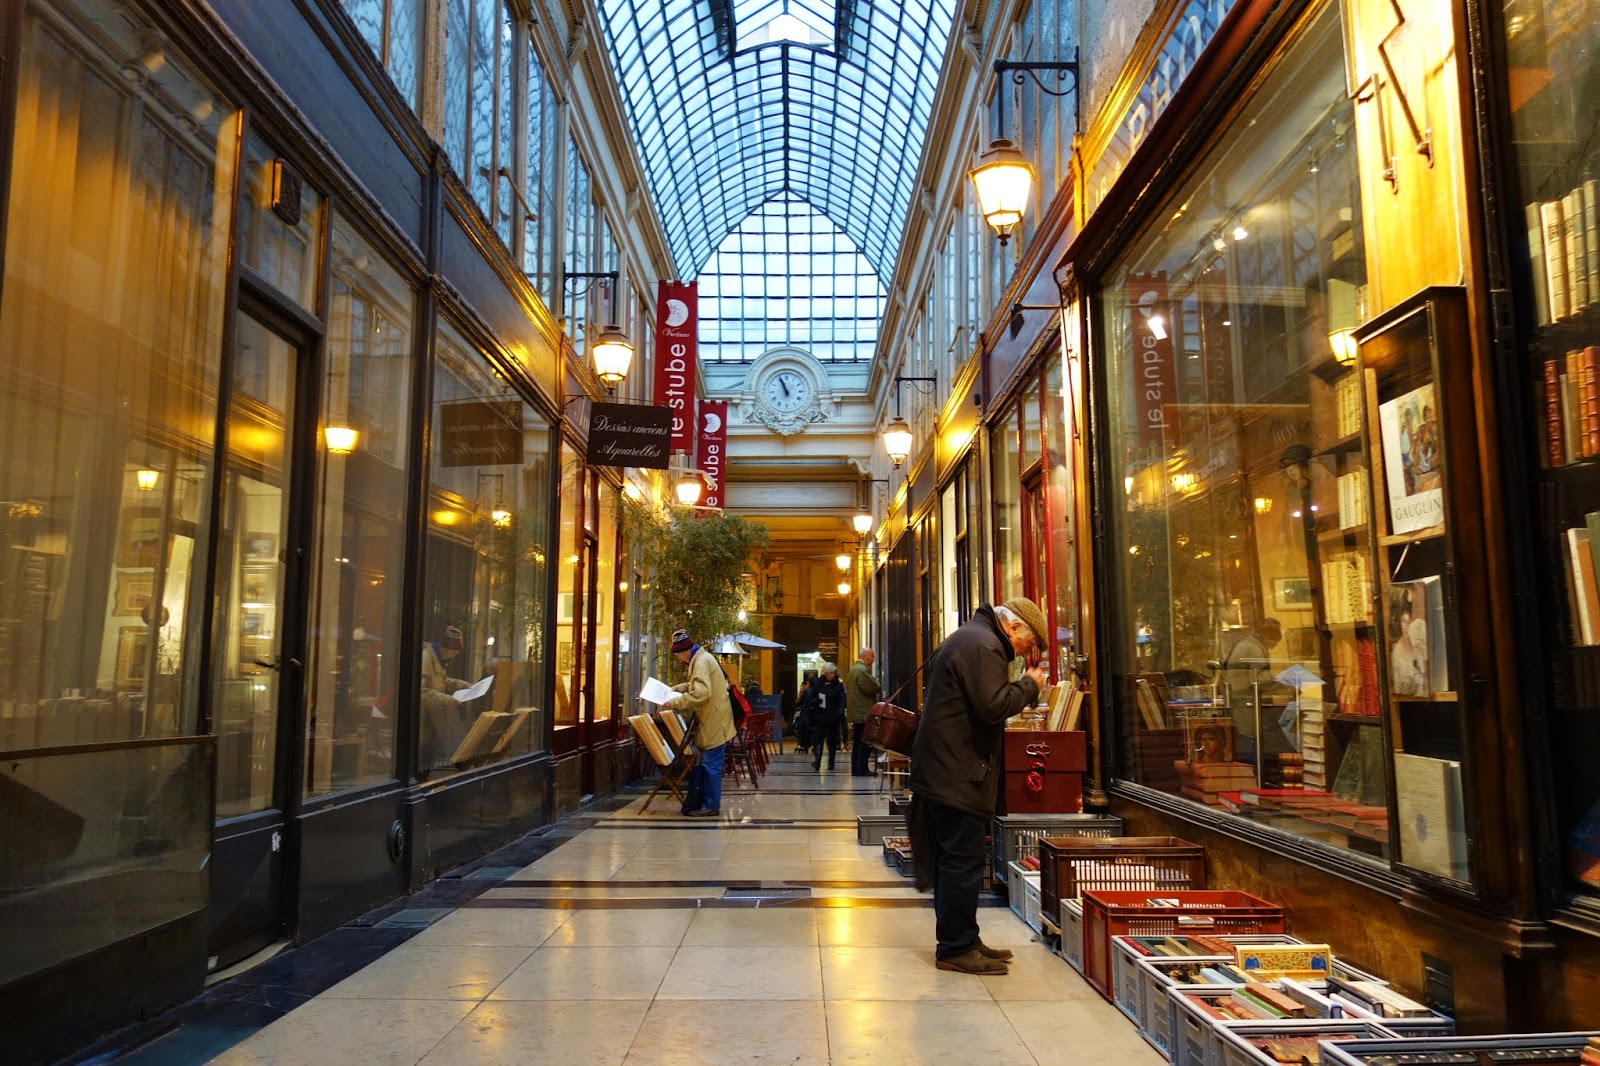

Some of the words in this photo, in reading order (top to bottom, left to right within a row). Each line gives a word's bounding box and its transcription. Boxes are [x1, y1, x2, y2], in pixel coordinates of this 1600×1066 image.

[664, 343, 686, 410] stube
[592, 414, 632, 433] Dessins
[632, 423, 668, 435] anciens
[597, 440, 662, 461] Aquarelles
[1395, 497, 1441, 521] GAUGUIN
